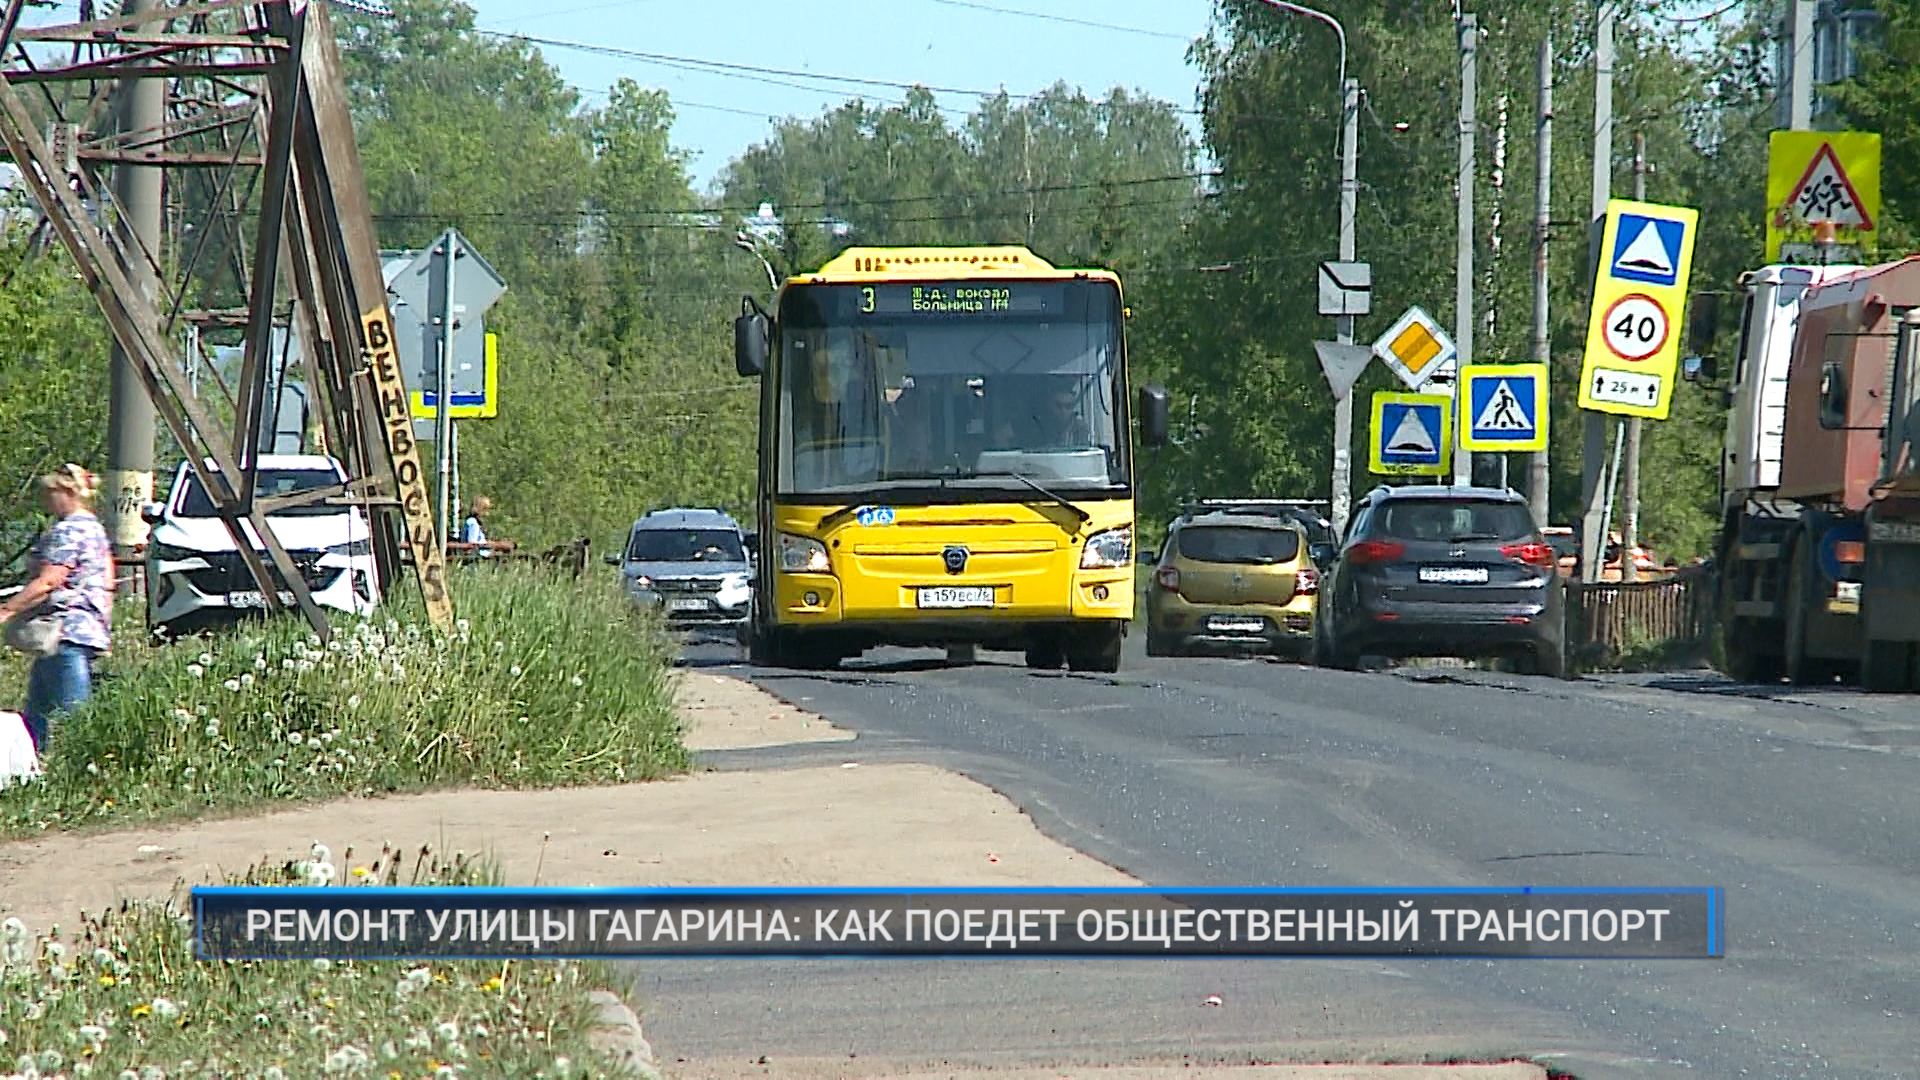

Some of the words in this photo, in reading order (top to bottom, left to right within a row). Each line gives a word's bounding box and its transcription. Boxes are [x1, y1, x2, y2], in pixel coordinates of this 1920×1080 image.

[862, 286, 875, 313] 3
[912, 299, 983, 312] Больница
[1613, 313, 1656, 343] 40
[1610, 381, 1629, 394] 25
